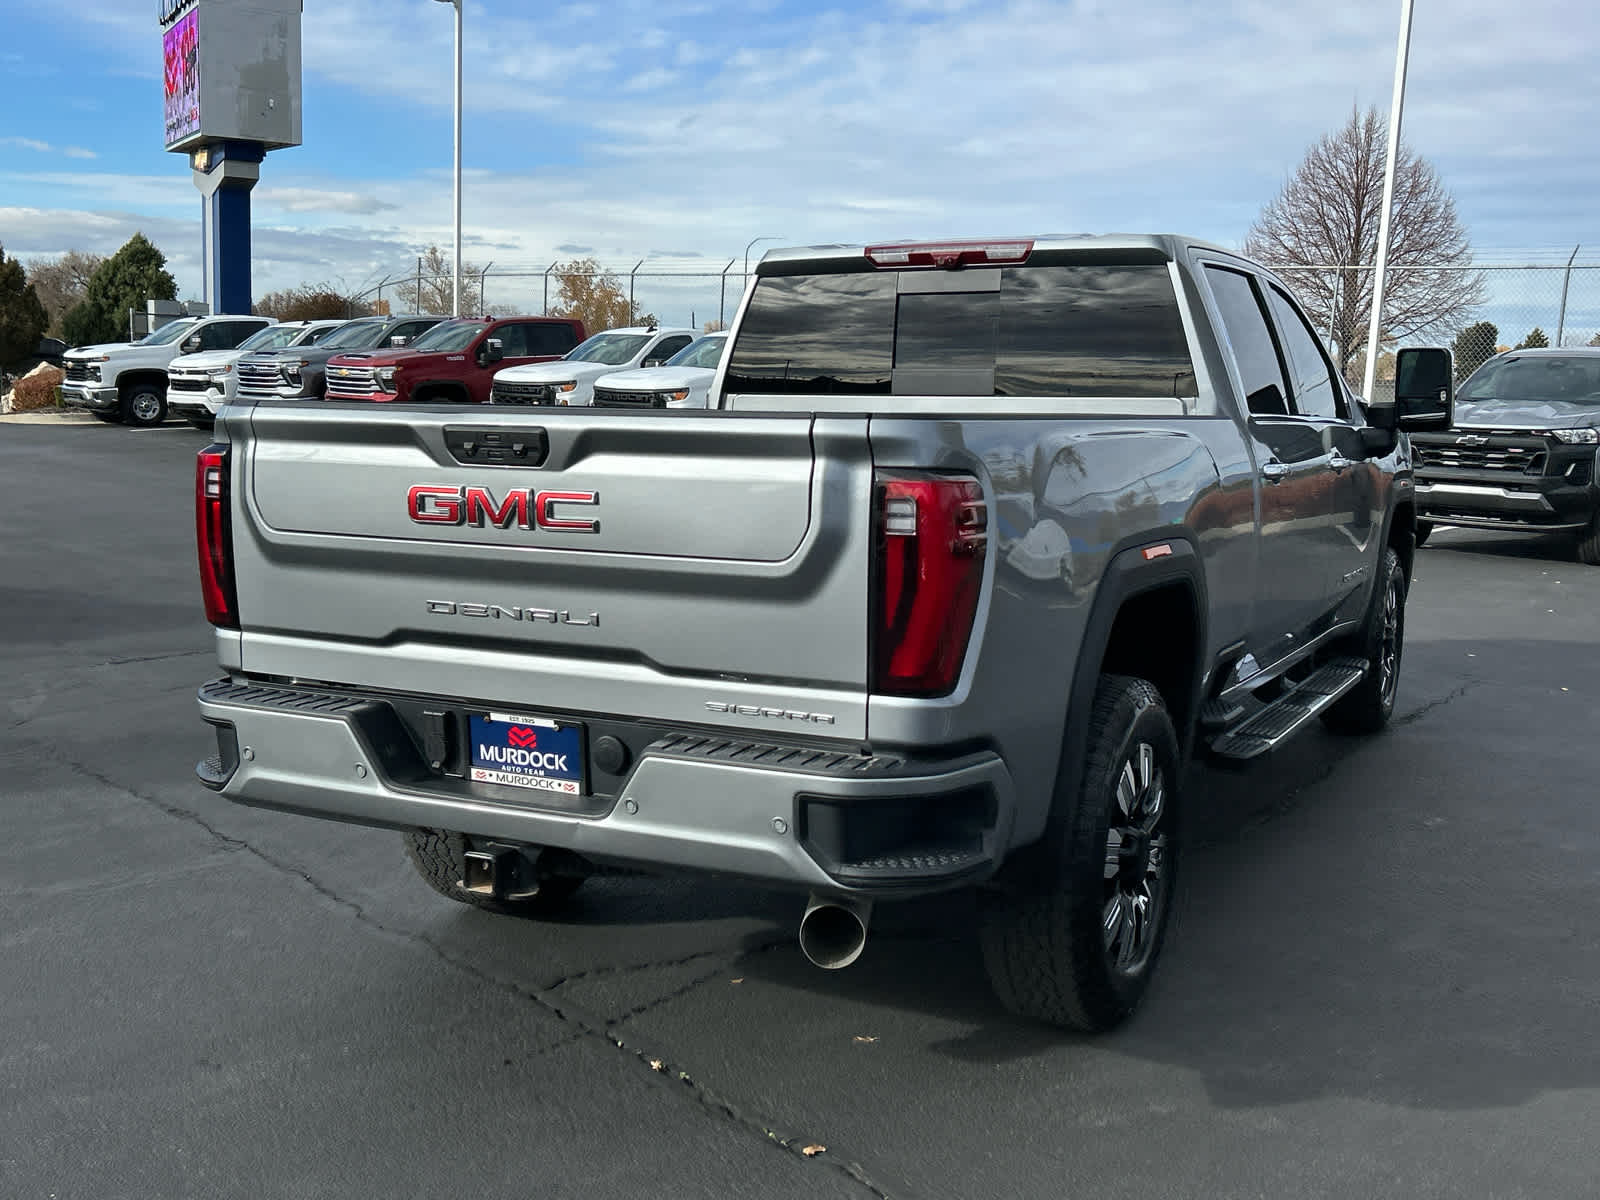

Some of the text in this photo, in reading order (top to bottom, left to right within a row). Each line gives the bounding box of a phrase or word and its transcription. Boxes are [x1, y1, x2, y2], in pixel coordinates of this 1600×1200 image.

[408, 485, 600, 534] GMC
[426, 600, 600, 627] DENALI
[704, 701, 835, 724] SIERRA
[480, 744, 568, 771] MURDOCK
[495, 772, 555, 789] MURDOCK
[501, 765, 545, 776] AUTO TEAM
